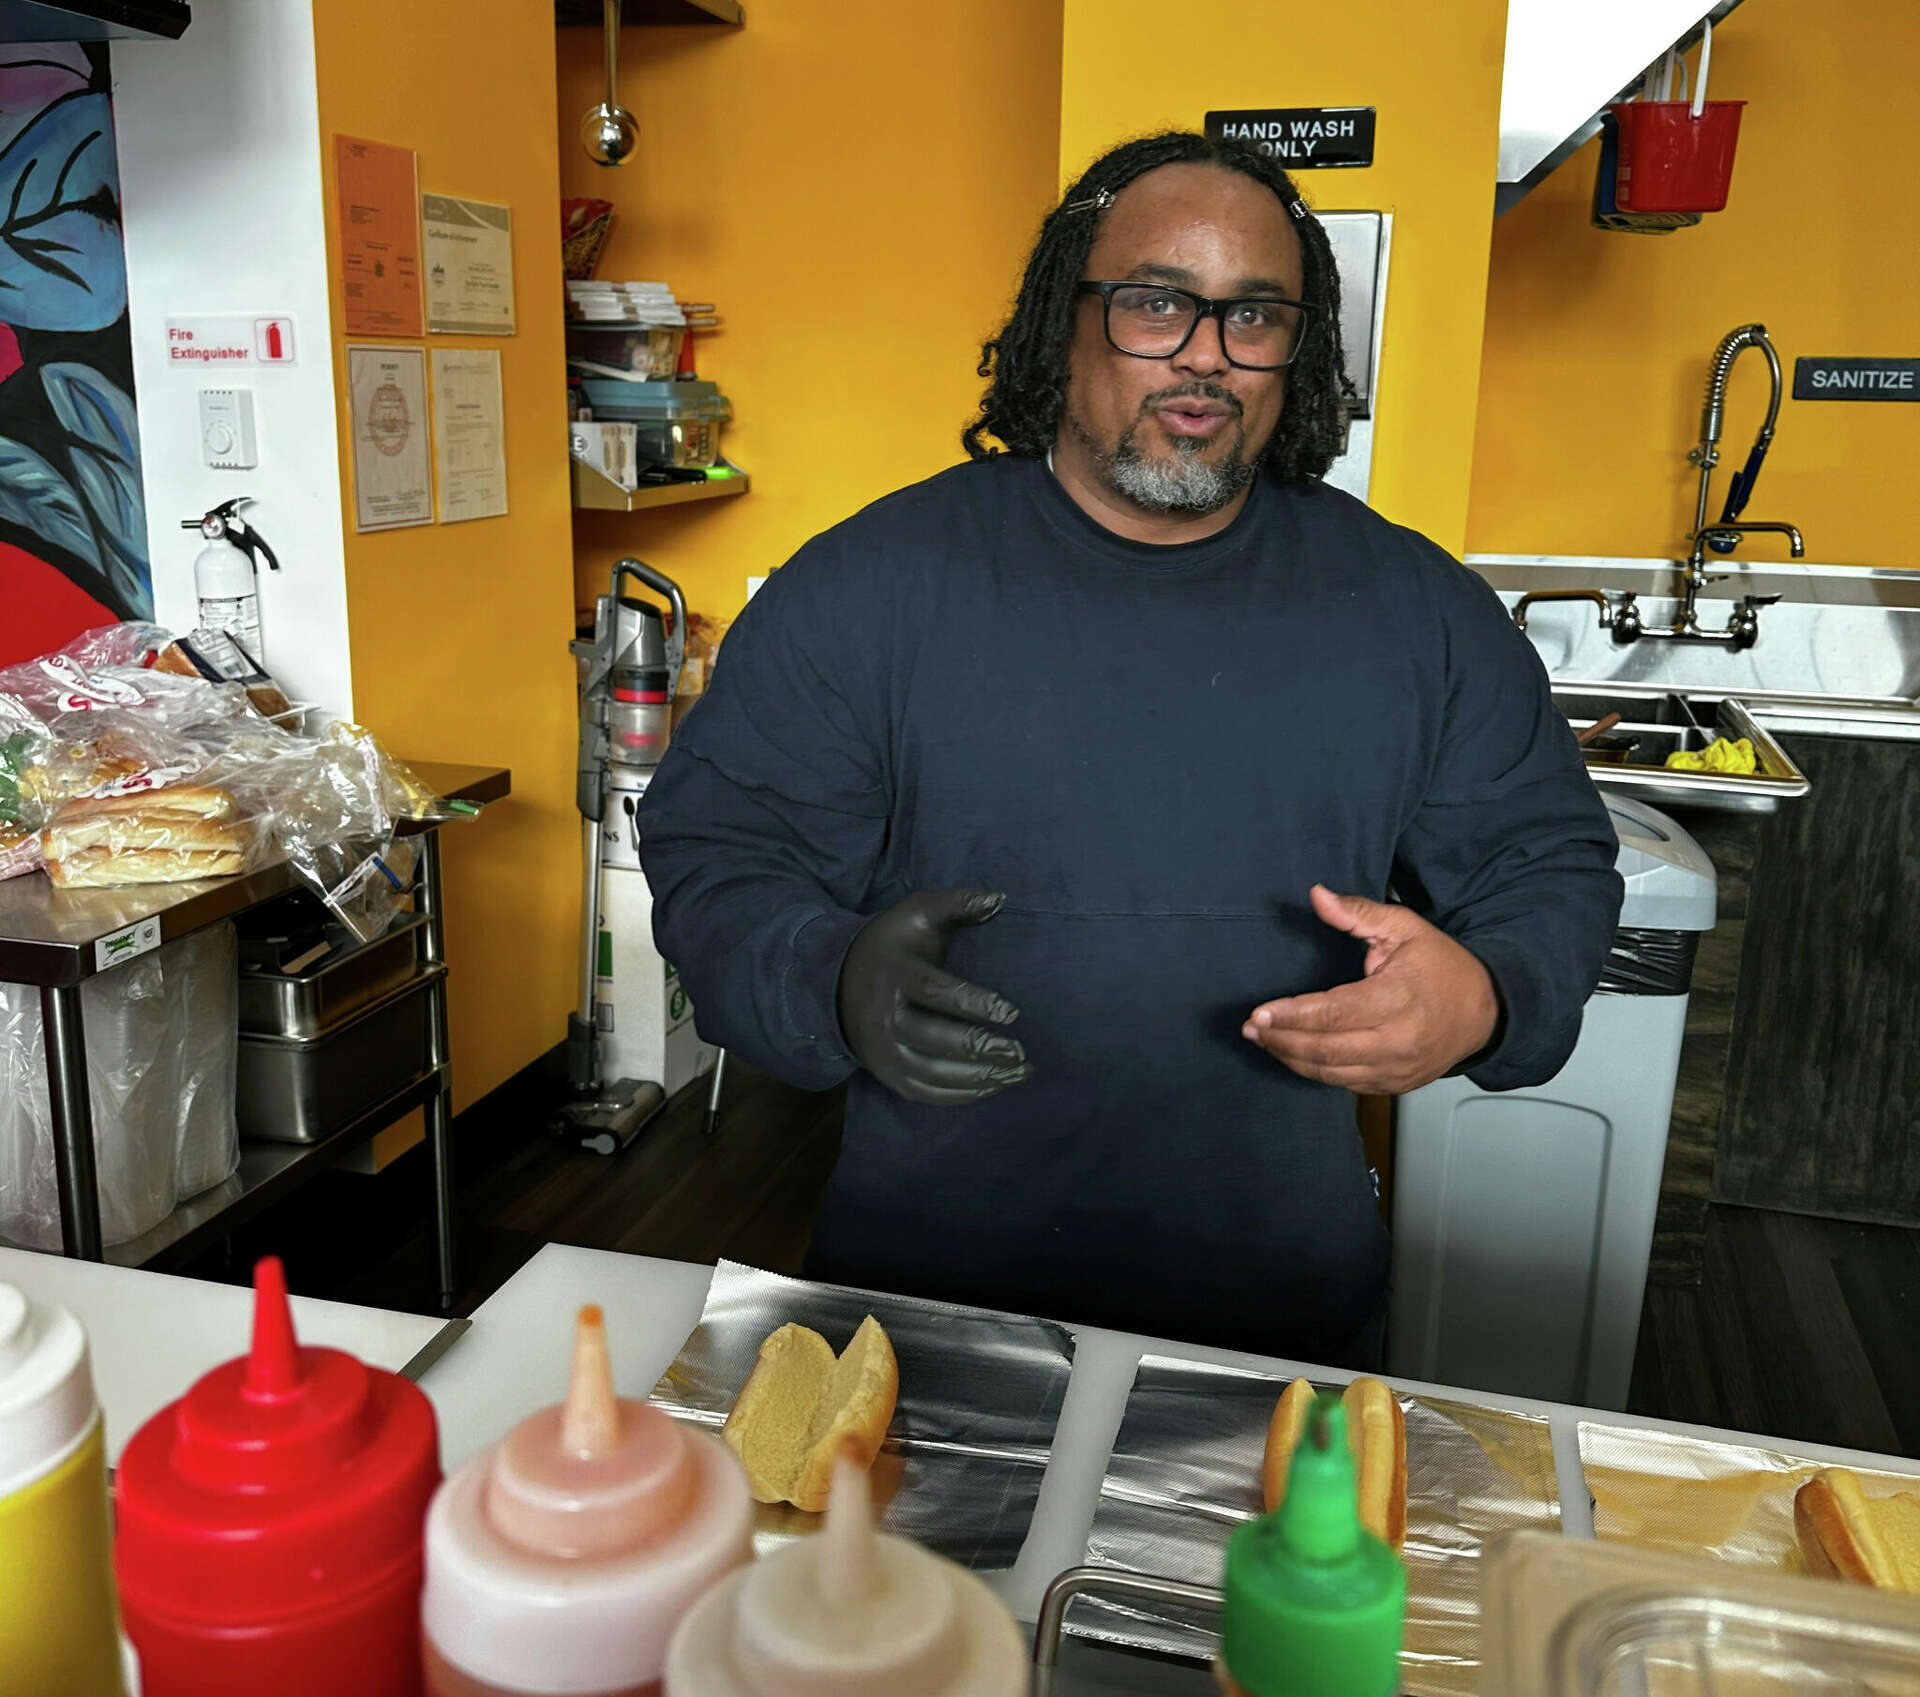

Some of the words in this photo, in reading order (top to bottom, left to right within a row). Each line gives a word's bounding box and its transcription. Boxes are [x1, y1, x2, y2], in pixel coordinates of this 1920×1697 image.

[1223, 123, 1282, 139] HAND
[1290, 120, 1354, 138] WASH
[1258, 140, 1317, 157] ONLY
[169, 329, 193, 340] Fire
[171, 346, 248, 361] Extinguisher
[1812, 370, 1914, 389] SANITIZE
